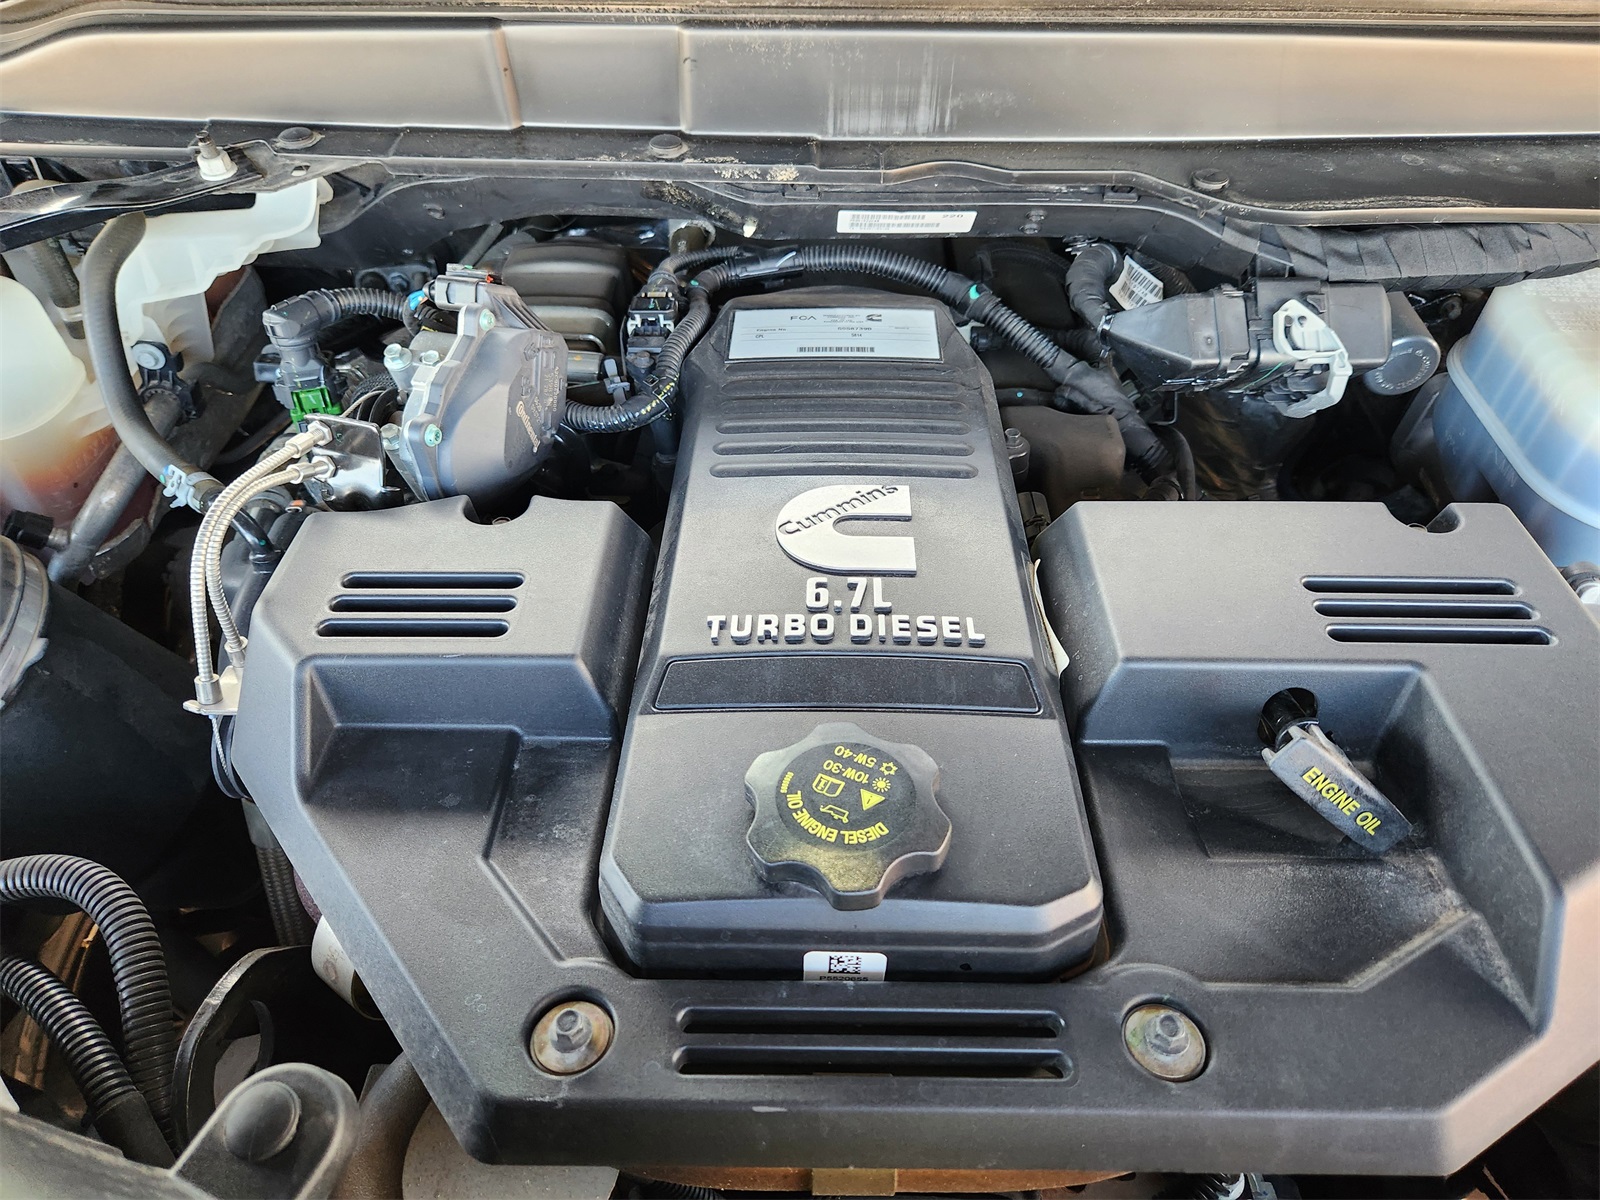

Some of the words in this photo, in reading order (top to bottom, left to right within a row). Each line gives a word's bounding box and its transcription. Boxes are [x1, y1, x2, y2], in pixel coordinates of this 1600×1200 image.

[516, 400, 541, 447] Continental
[777, 483, 899, 535] Cummins
[805, 577, 892, 613] 6.7L
[707, 614, 835, 645] TURBO
[850, 614, 986, 648] DIESEL
[822, 759, 870, 784] 10W-30
[834, 745, 877, 768] 5W-40
[786, 789, 804, 810] OIL
[1302, 766, 1361, 816] ENGINE
[1355, 810, 1382, 836] OIL
[792, 807, 839, 843] ENGINE
[840, 821, 889, 845] DIESEL
